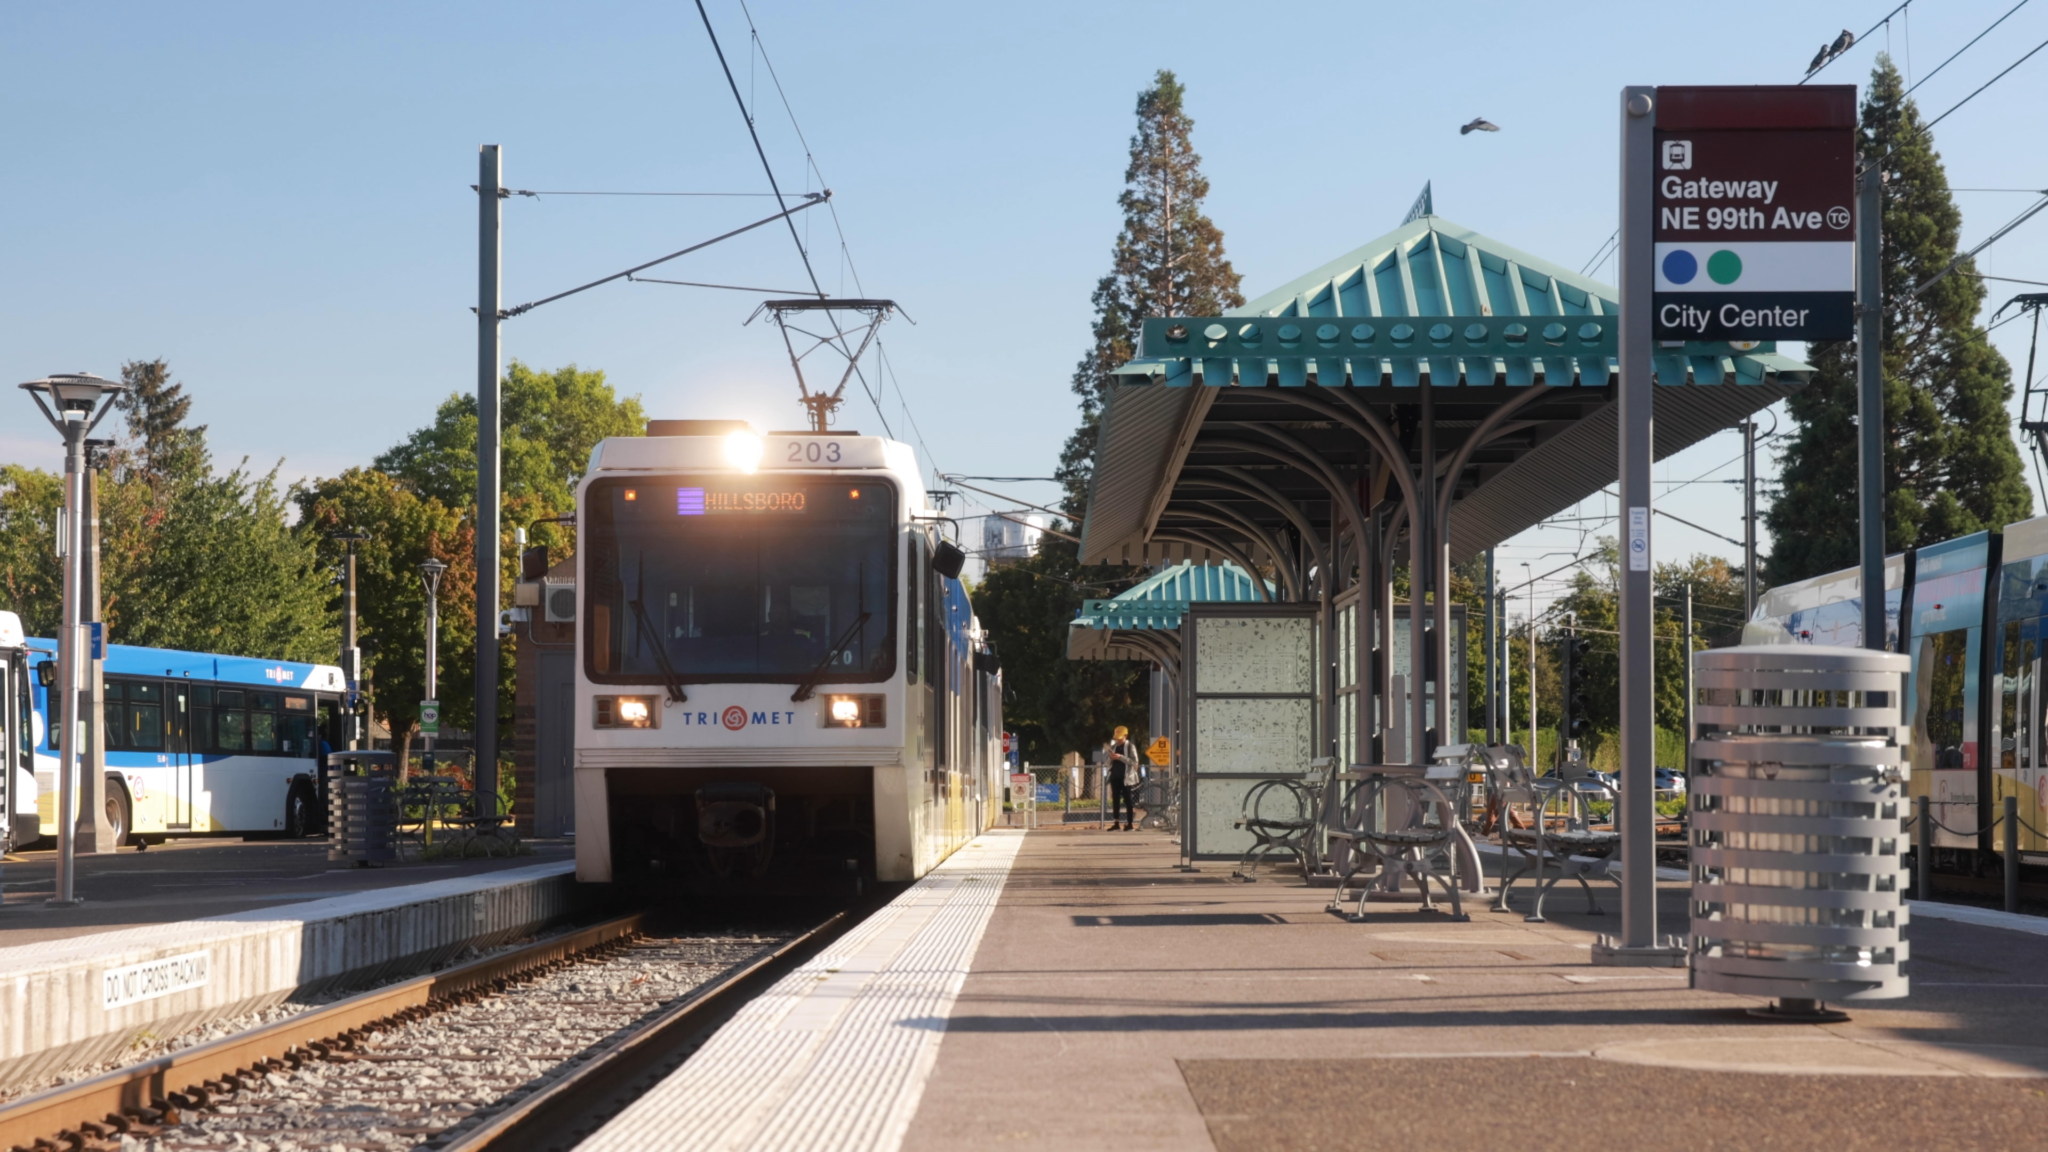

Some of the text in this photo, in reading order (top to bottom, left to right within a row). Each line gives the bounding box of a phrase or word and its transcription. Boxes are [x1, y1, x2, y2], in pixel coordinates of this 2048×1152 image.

[1661, 175, 1778, 204] Gateway
[1661, 207, 1849, 230] NE 99th Ave TC
[1660, 304, 1809, 333] City Center
[787, 441, 841, 463] 203
[705, 492, 805, 511] HILLSBORO
[423, 711, 436, 720] hop
[107, 975, 120, 1003] DO
[123, 970, 137, 999] NOT
[141, 964, 169, 995] CROSS
